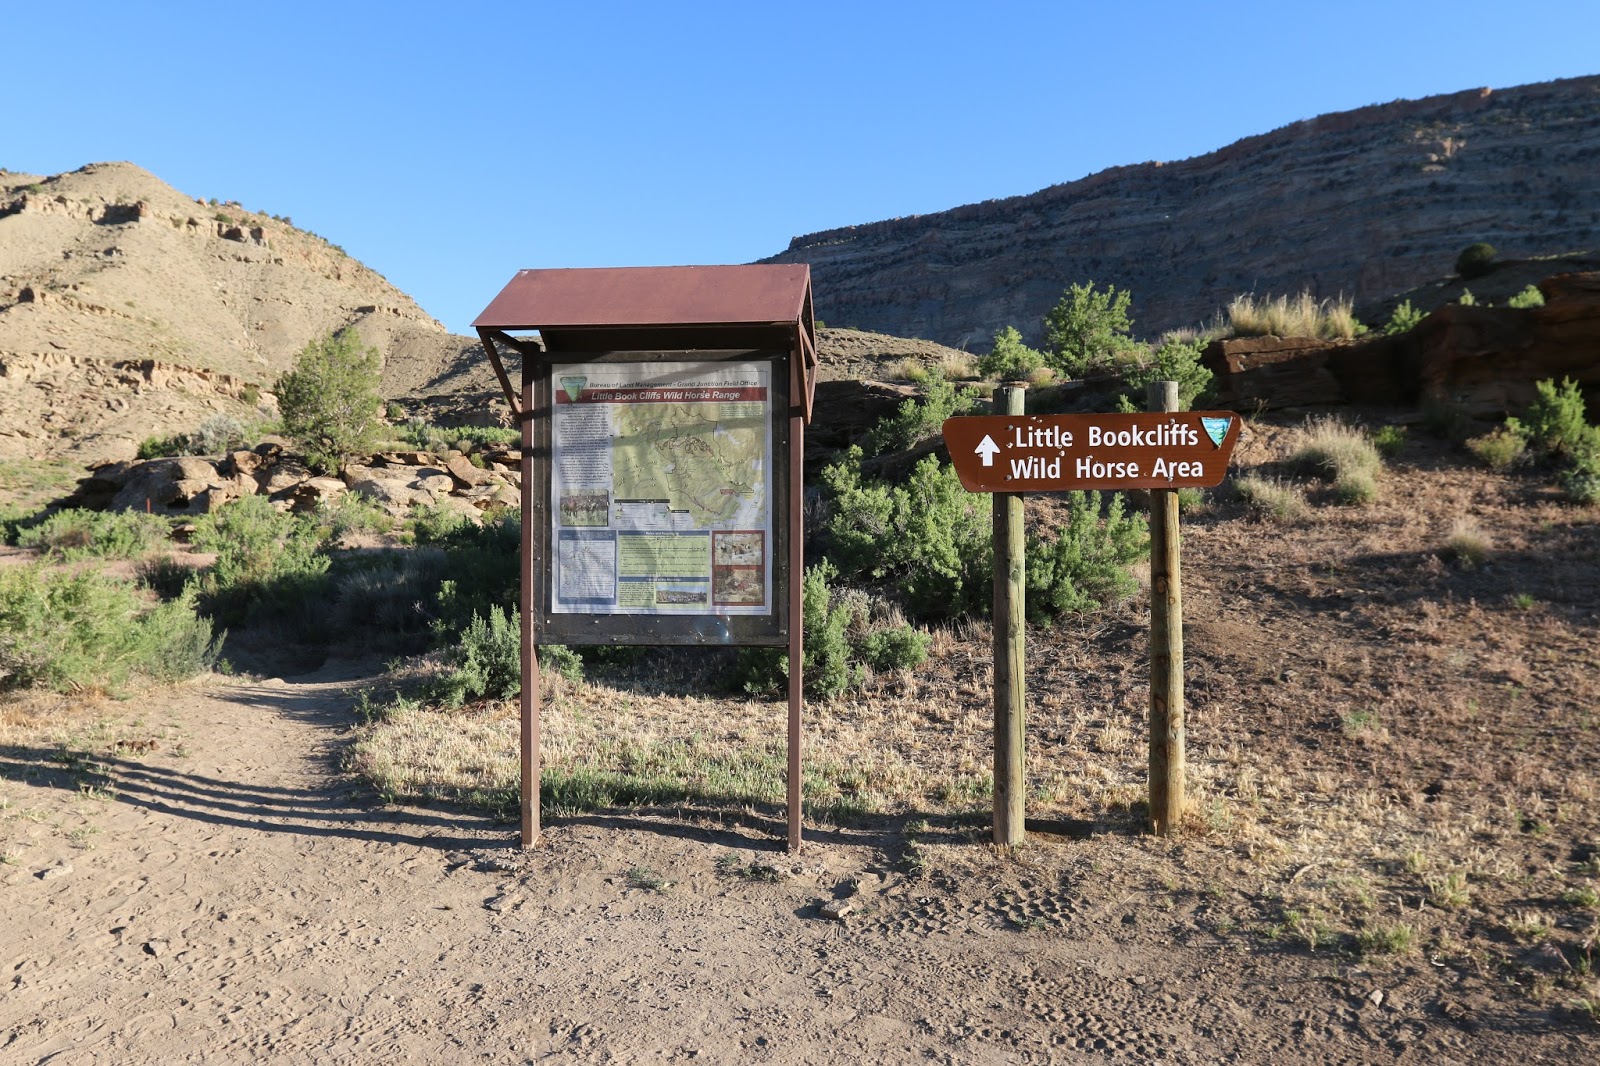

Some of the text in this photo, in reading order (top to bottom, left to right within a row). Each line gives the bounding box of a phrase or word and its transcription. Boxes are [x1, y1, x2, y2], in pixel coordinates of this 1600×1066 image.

[634, 381, 672, 389] Management
[591, 390, 741, 400] Little Book Cliffs Wild Horse Range
[1015, 423, 1199, 448] Little Bookcliffs
[1010, 457, 1204, 480] Wild Horse Area
